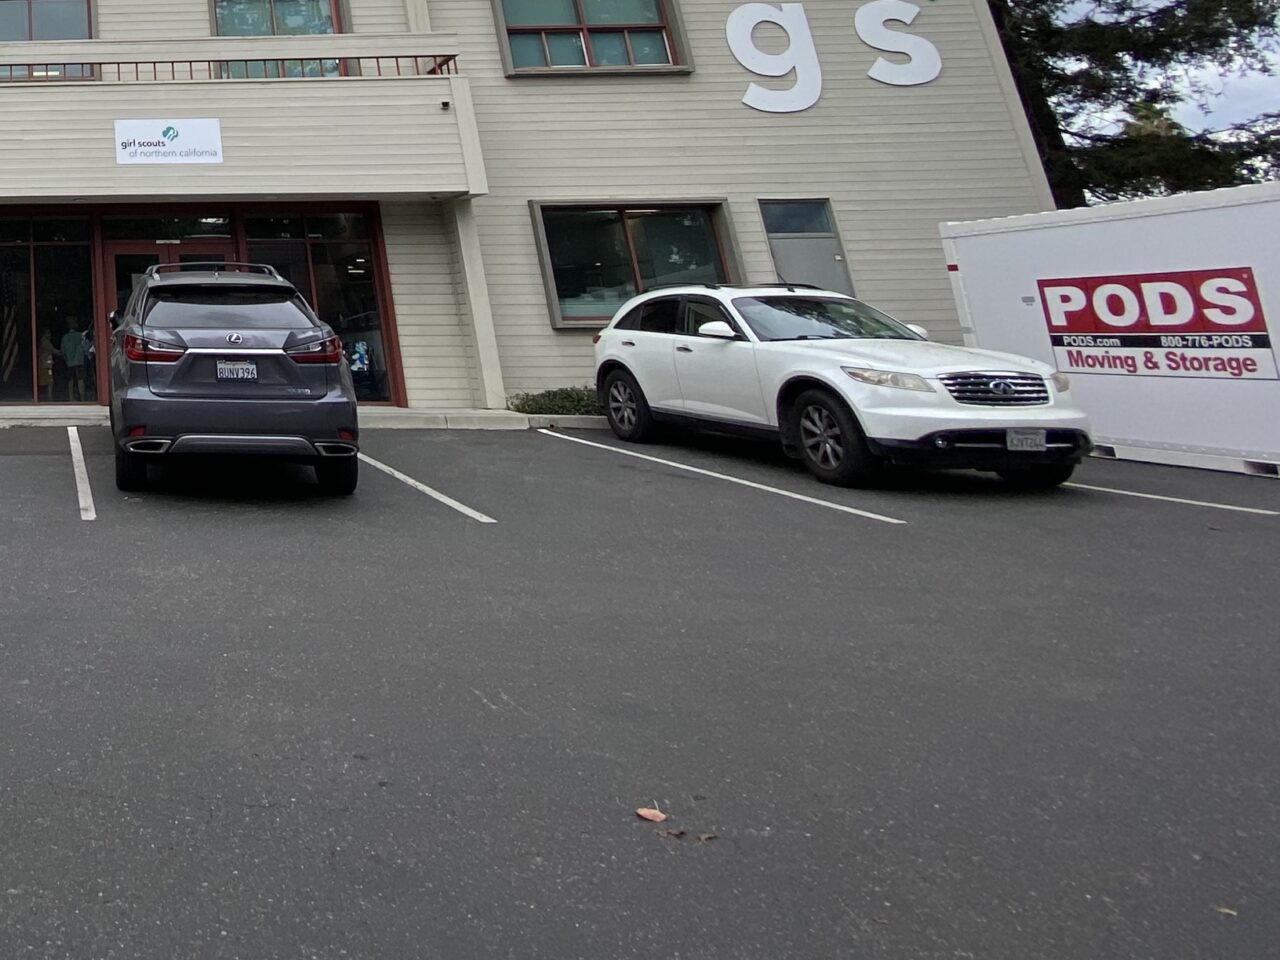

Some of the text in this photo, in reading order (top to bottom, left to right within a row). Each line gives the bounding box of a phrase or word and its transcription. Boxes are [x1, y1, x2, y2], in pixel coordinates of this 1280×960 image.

[121, 139, 166, 149] girl scouts
[129, 148, 218, 158] of northern california
[1043, 277, 1255, 327] PODS
[1062, 335, 1253, 347] PODS.com 800-776-PODS
[1066, 349, 1258, 377] Moving & Storage
[218, 367, 256, 378] 8UNV396
